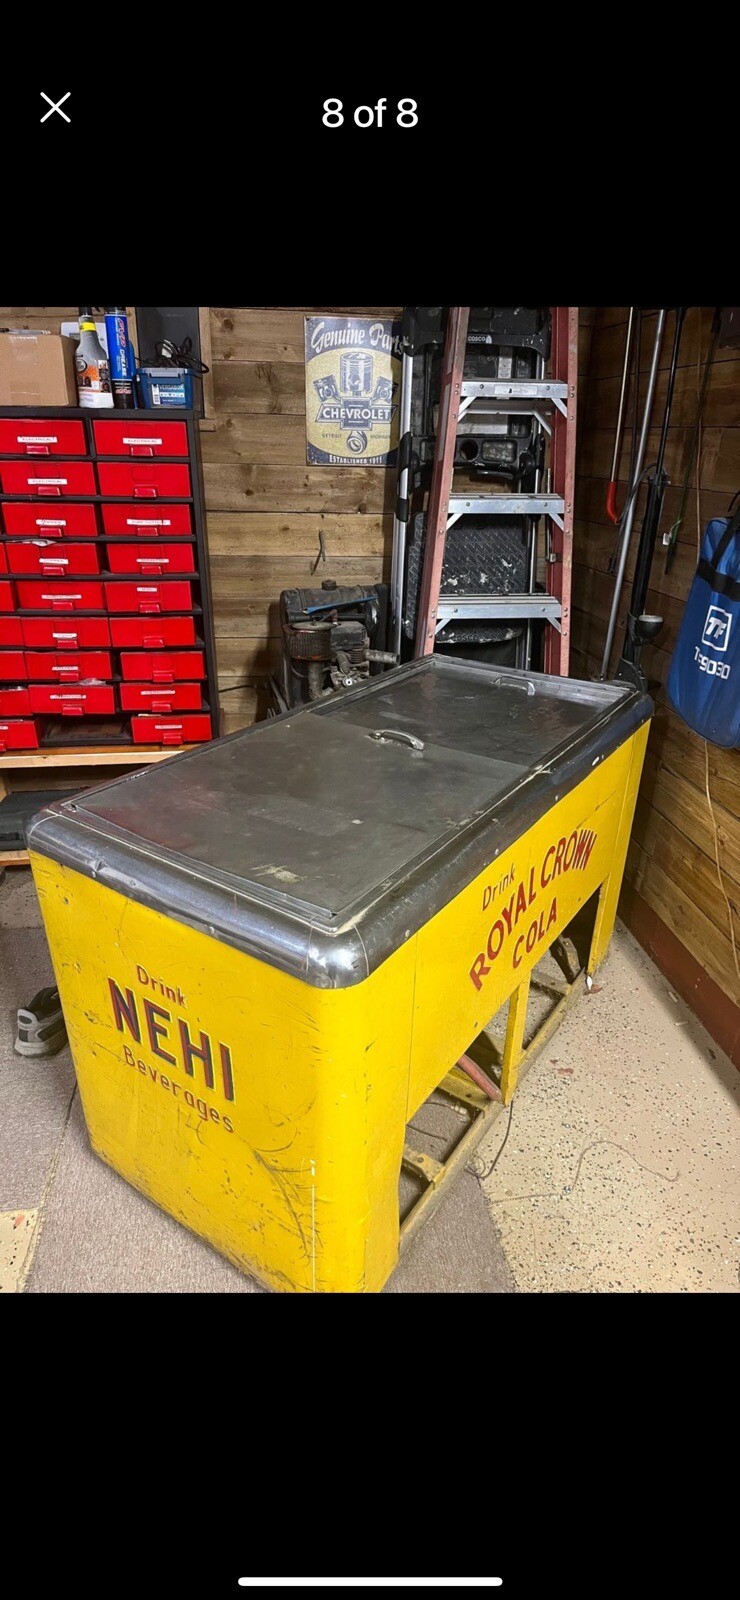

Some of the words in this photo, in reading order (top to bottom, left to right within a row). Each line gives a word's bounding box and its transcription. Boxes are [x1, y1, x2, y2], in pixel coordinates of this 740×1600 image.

[311, 321, 365, 353] Genuine
[322, 408, 390, 419] CHEVROLET
[329, 455, 367, 464] ESTABLISHED
[469, 866, 537, 991] ROYAL
[541, 829, 597, 889] CROWN
[482, 863, 515, 911] Drink
[512, 897, 557, 969] COLA
[136, 964, 187, 1007] Drink
[107, 977, 235, 1105] NEHI
[123, 1044, 234, 1133] Beverages
